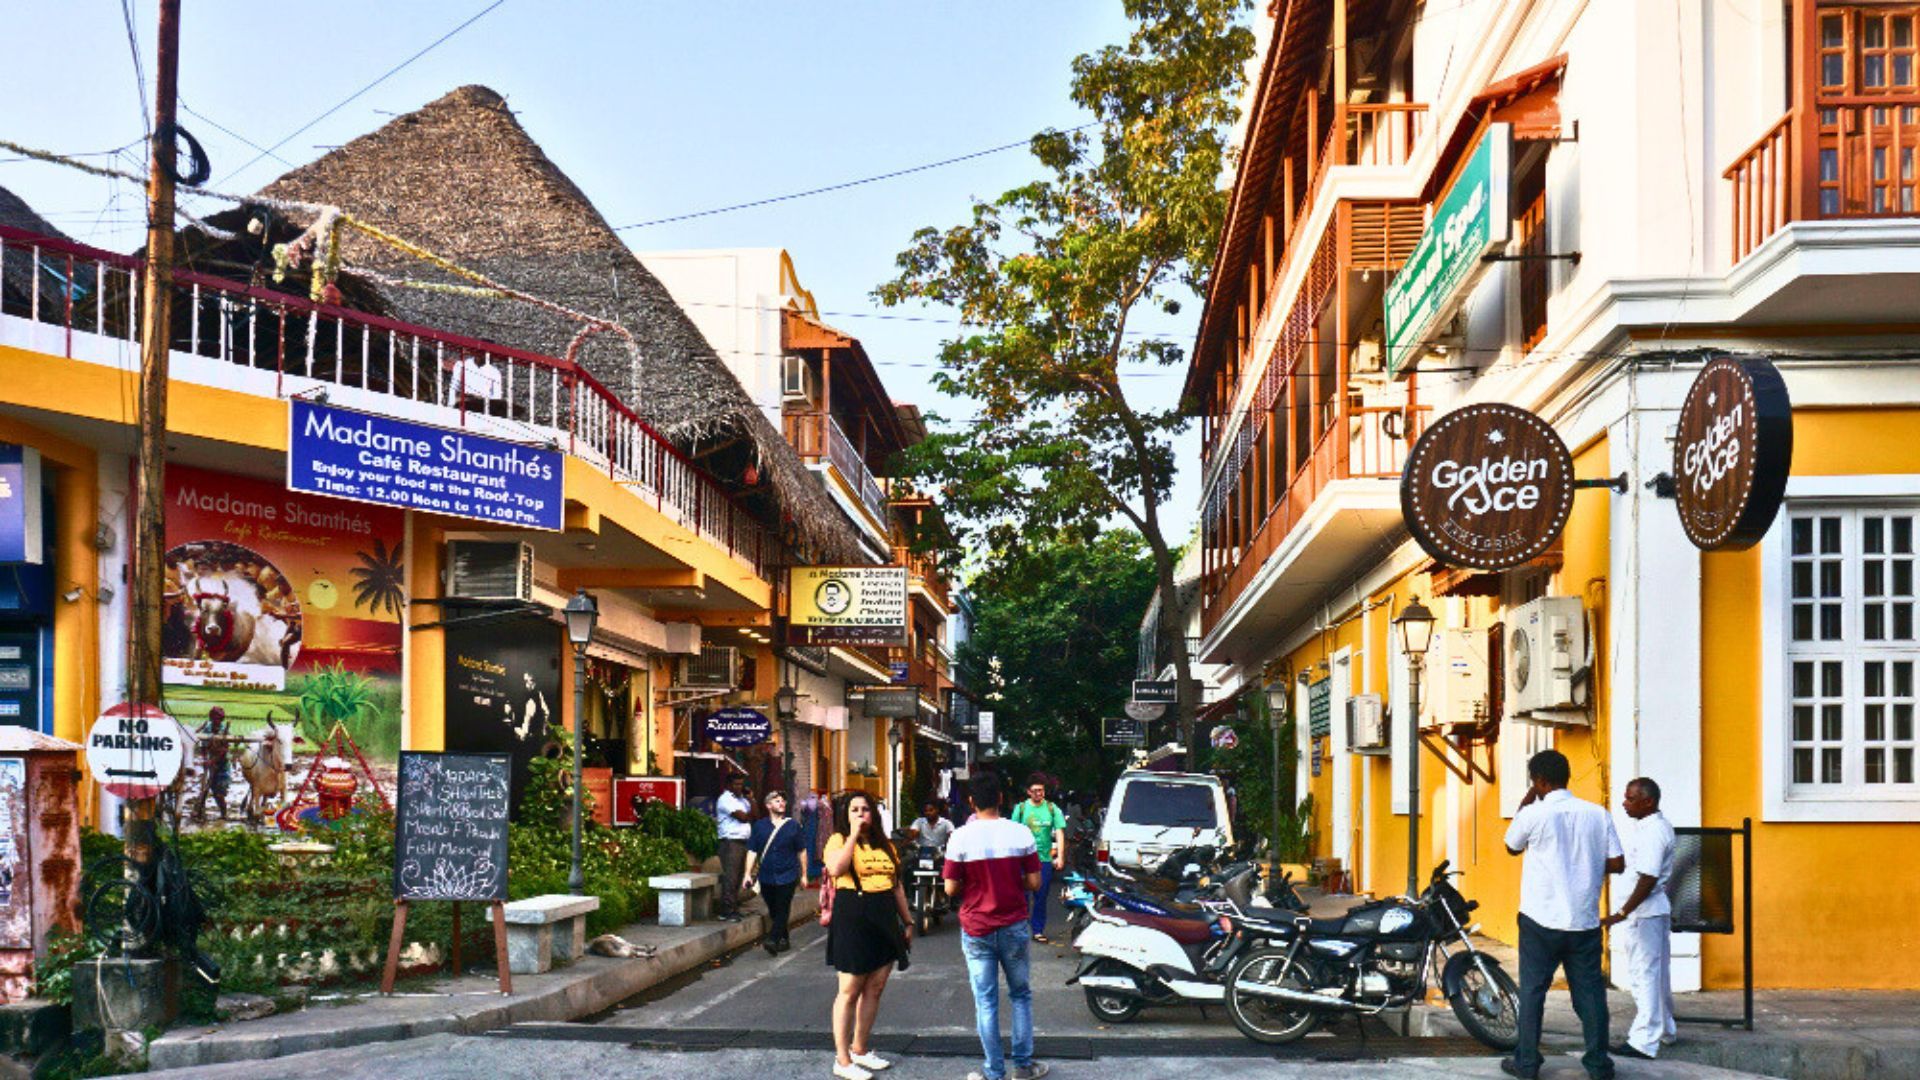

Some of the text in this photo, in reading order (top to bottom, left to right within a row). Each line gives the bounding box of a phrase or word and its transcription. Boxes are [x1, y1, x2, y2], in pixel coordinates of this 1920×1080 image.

[1443, 180, 1483, 259] Spa
[304, 410, 552, 481] Madame Shanthés
[1683, 403, 1743, 477] Golden
[312, 460, 544, 511] Enjoy your food at the Roof-Top
[358, 450, 506, 489] Café Restaurant
[1431, 454, 1549, 489] Golden
[1692, 437, 1741, 494] Ace
[177, 486, 372, 535] Madame Shanthés
[314, 477, 361, 495] Time:
[366, 486, 410, 503] 12.00
[412, 493, 450, 510] Noon
[454, 500, 469, 512] to
[475, 503, 513, 519] 11.00
[1447, 472, 1541, 516] Ace
[258, 524, 332, 547] Restaurant
[92, 734, 174, 751] PARKING
[118, 719, 149, 734] NO
